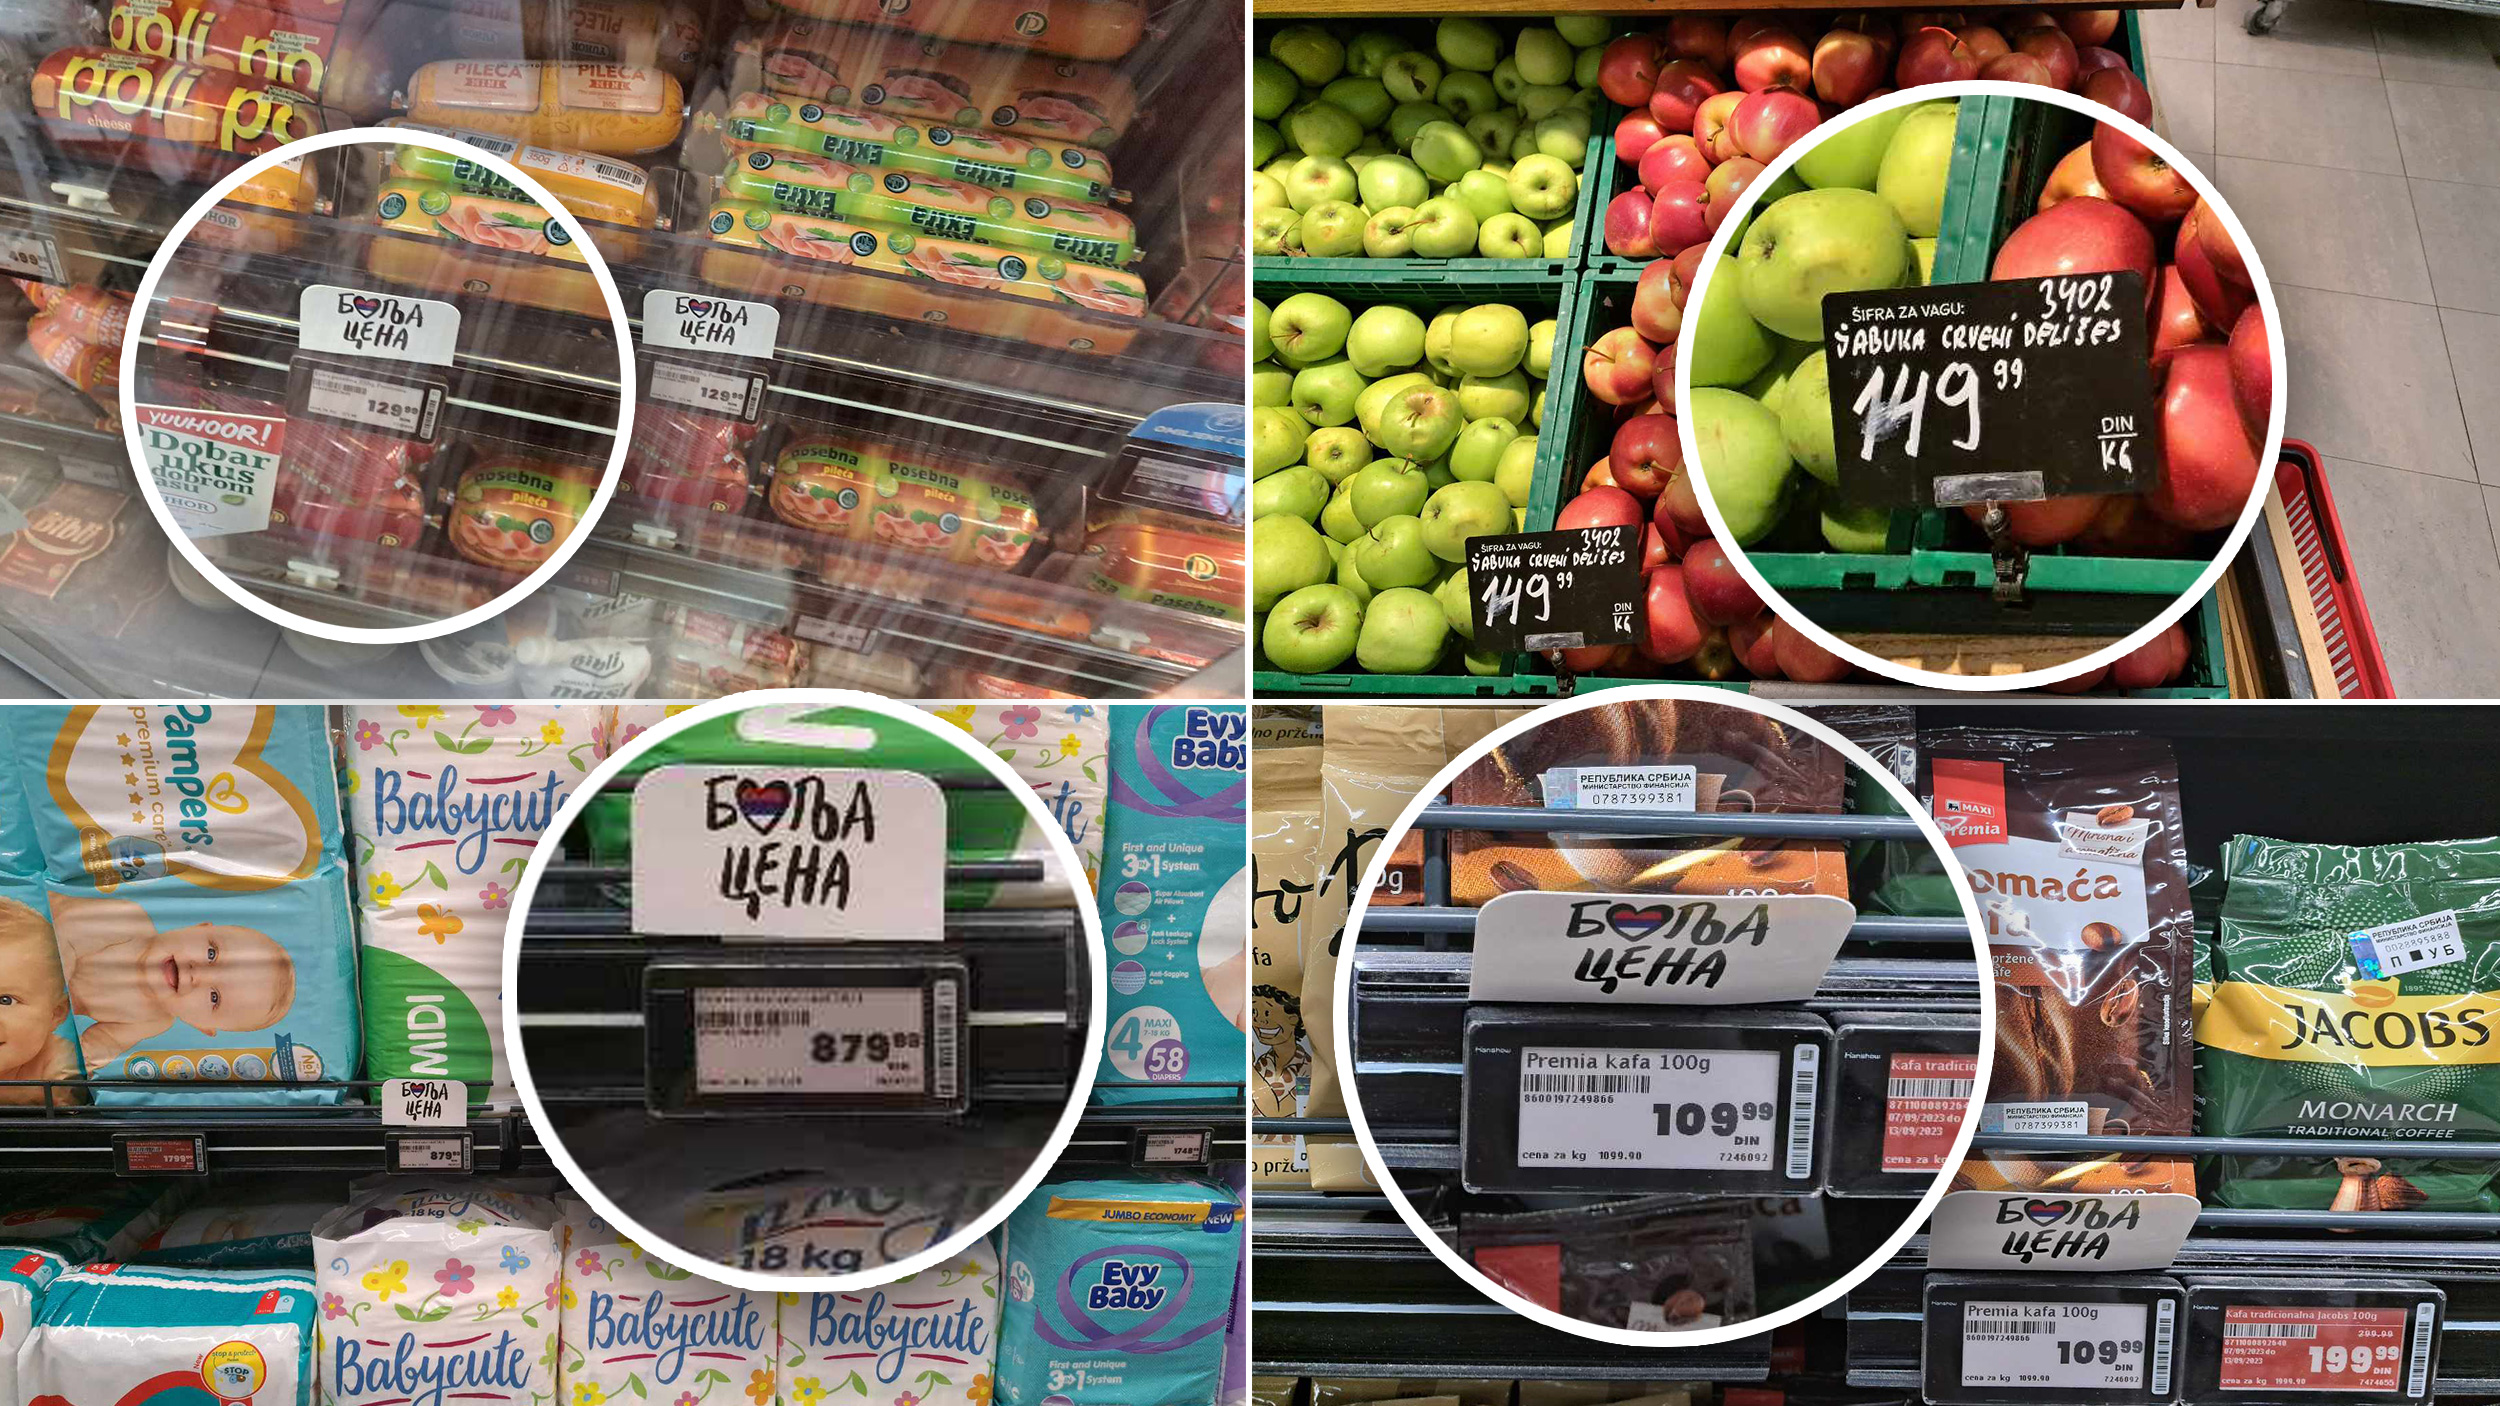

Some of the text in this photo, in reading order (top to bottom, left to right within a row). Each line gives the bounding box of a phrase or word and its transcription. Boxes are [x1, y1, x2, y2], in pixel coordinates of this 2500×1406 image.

[59, 56, 203, 120] poli
[87, 114, 132, 132] cheese
[823, 135, 883, 165] Extra
[954, 159, 1016, 188] Extra
[773, 182, 836, 213] Extra
[911, 206, 977, 236] Extra
[1054, 232, 1120, 262] Extra
[2039, 275, 2113, 320] 3402
[1852, 303, 1966, 323] ŠIFRA ZA VAGU:
[343, 321, 409, 350] ЦЕНА
[680, 320, 735, 346] ЦЕНА
[701, 387, 731, 402] 129
[368, 399, 403, 418] 129
[1852, 358, 2023, 461] 149 99
[149, 410, 272, 447] YUUHOOR!
[2101, 416, 2134, 432] DIN
[149, 430, 271, 470] Dobar
[2101, 440, 2133, 473] KG
[161, 452, 255, 484] ukus
[823, 464, 854, 480] pileća
[151, 465, 254, 496] dobrom
[512, 491, 548, 509] pileća
[924, 488, 956, 503] pileća
[1481, 542, 1504, 553] ŠIFRA
[1518, 542, 1542, 550] VAGU:
[1581, 527, 1621, 550] 3402
[1481, 572, 1573, 627] 149 99
[1614, 602, 1632, 612] DIN
[1613, 615, 1632, 633] KG
[127, 706, 168, 843] premium care
[1580, 773, 1691, 783] РЕПУБЛИКА СРБИЈА
[1592, 793, 1682, 805] 0787399381
[1962, 802, 1993, 815] MAXI
[1122, 843, 1203, 855] First and Unique
[1122, 854, 1201, 878] 3 1 System
[720, 843, 852, 920] ЦЕНА
[2372, 914, 2453, 939] РЕПУБЛИКА СРБИЈА
[2376, 931, 2418, 944] МИНИСТАРСТВО
[2385, 931, 2451, 952] 0028895888
[2391, 944, 2455, 968] П Б
[1574, 946, 1727, 994] ЦЕНА
[2404, 984, 2424, 993] 1895
[1144, 1019, 1172, 1028] MAXI
[2281, 1003, 2490, 1050] JACOBS
[405, 994, 449, 1076] MIDI
[1111, 1016, 1143, 1061] 4
[811, 1032, 891, 1063] 879
[1148, 1047, 1184, 1073] 58
[1526, 1053, 1711, 1073] Premia kafa 100g
[1891, 1059, 1922, 1071] Kafa
[1152, 1073, 1182, 1081] DIAPERS
[1524, 1094, 1614, 1104] 8600197249866
[406, 1100, 441, 1121] ЦЕНА
[1653, 1101, 1774, 1137] 109 99
[1888, 1113, 1961, 1124] 07/09/2023 do
[2005, 1106, 2085, 1115] РЕПУБЛИКА СРБИЈА
[2298, 1100, 2458, 1122] MONARCH
[1888, 1126, 1943, 1137] 13/09/2023
[2014, 1121, 2079, 1130] 0787399381
[2287, 1125, 2456, 1139] TRADITIONAL COFFEE
[1734, 1136, 1760, 1146] DIN
[164, 1155, 186, 1163] 1799
[430, 1151, 452, 1160] 879
[1522, 1150, 1642, 1162] cena za kg 1099.90
[1719, 1152, 1769, 1163] 7246092
[1885, 1156, 1929, 1164] cena za
[425, 1207, 445, 1219] kg
[1102, 1209, 1196, 1222] JUMBO ECONOMY
[1204, 1212, 1233, 1226] NEW
[2001, 1229, 2110, 1264] ЦЕНА
[1102, 1261, 1161, 1287] Evy
[1089, 1285, 1166, 1310] Baby
[1968, 1305, 2099, 1320] Premia kafa 100g
[2226, 1309, 2377, 1322] Kafa tradicionalna Jacobs 100g
[588, 1289, 766, 1385] Babycute
[1966, 1334, 2030, 1342] 8600197249866
[2057, 1340, 2143, 1365] 109 99
[2308, 1346, 2399, 1374] 199 99
[224, 1367, 250, 1376] STOP
[335, 1329, 532, 1406] Babycute
[2373, 1367, 2392, 1375] DIN
[1047, 1370, 1122, 1391] 3 System
[1964, 1374, 1984, 1382] cena
[1986, 1374, 1997, 1382] za
[1999, 1374, 2011, 1383] kg
[2221, 1377, 2241, 1385] cena
[2256, 1376, 2267, 1386] kg
